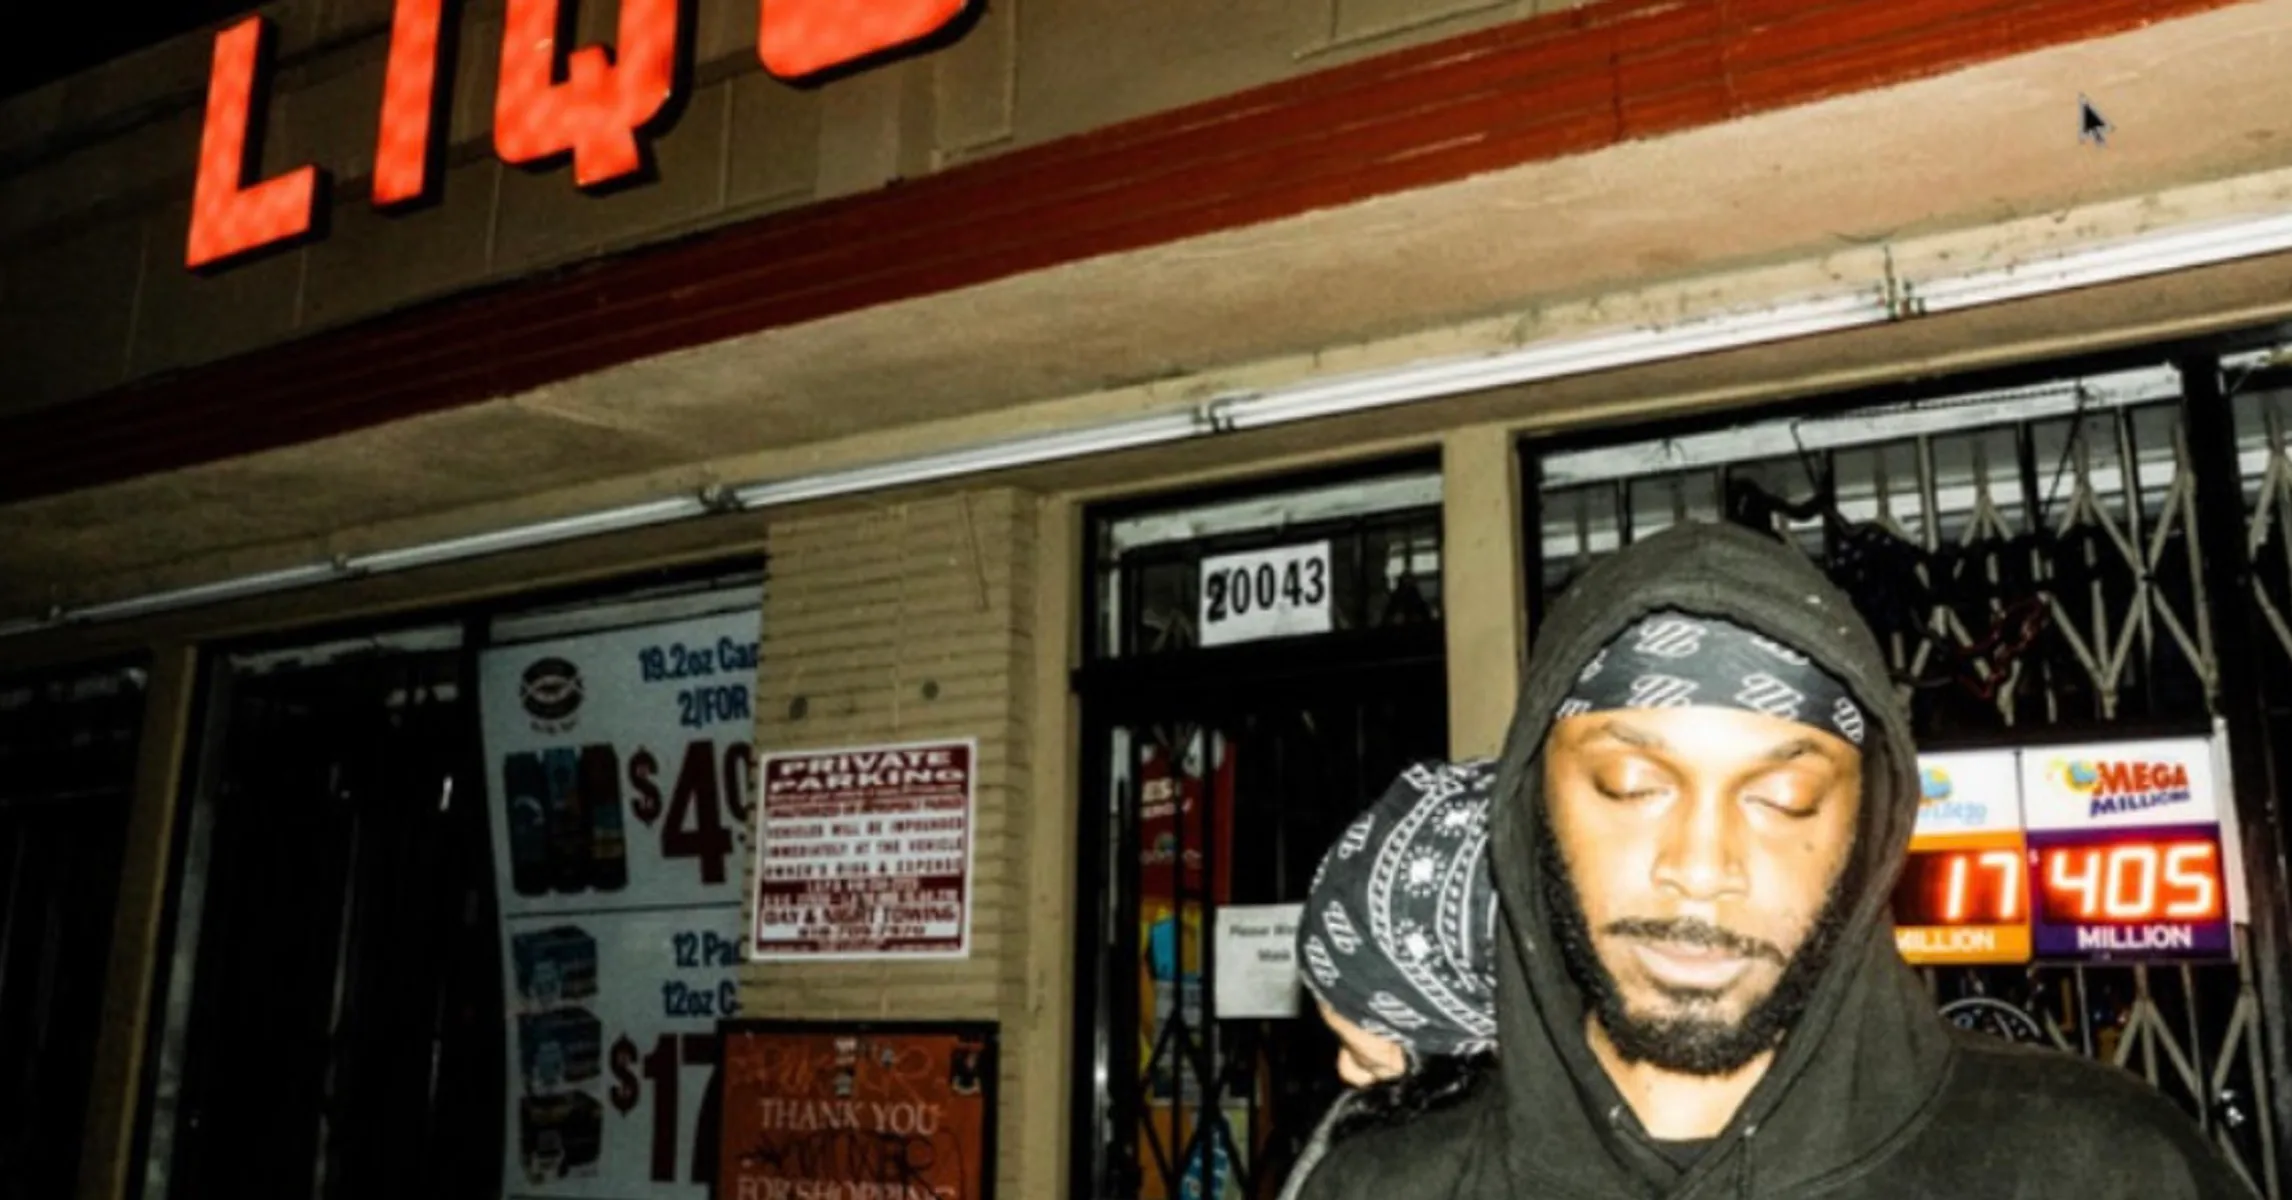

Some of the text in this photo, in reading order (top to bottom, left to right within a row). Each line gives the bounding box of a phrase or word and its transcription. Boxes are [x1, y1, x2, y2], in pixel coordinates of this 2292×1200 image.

[1205, 556, 1326, 624] 20043
[638, 642, 714, 683] 19.2oz
[770, 768, 965, 793] PARKING
[780, 751, 952, 776] PRIVATE
[2094, 760, 2190, 795] MEGA
[832, 821, 860, 837] WILL
[1944, 851, 2020, 920] 17
[2049, 843, 2217, 919] 405
[673, 930, 699, 967] 12
[2077, 925, 2193, 950] MILLION
[662, 980, 714, 1017] 12oz
[759, 1098, 943, 1136] THANK YOU
